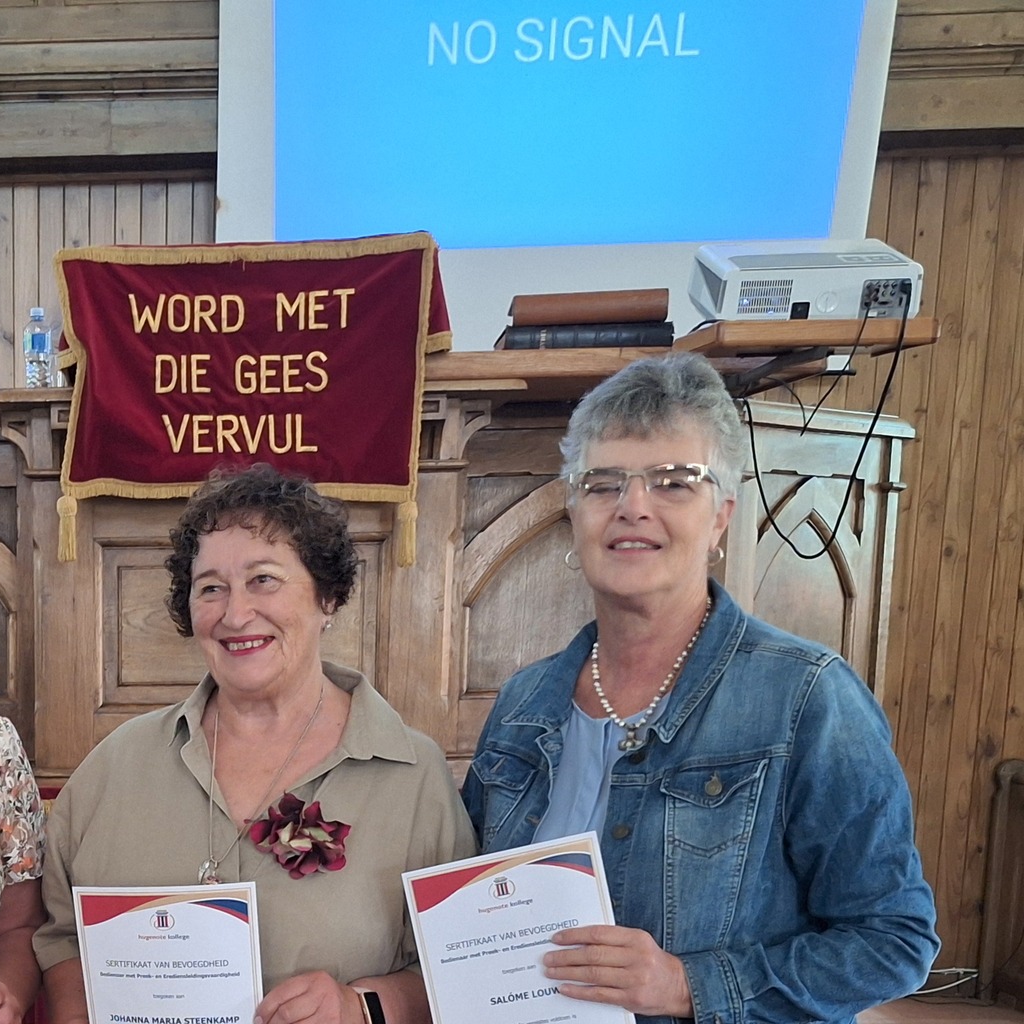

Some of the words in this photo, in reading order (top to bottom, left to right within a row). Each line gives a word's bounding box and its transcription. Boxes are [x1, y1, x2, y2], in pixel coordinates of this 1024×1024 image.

[428, 20, 497, 65] NO
[514, 12, 699, 62] SIGNAL
[128, 293, 245, 333] WORD
[276, 288, 355, 332] MET
[155, 354, 211, 394] DIE
[235, 351, 329, 394] GEES
[161, 413, 318, 454] VERVUL
[445, 935, 497, 952] SERTIFIKAAT
[499, 931, 517, 940] VAN
[519, 919, 579, 937] BEVOEGDHEID
[105, 960, 151, 969] SERTIFIKAAT
[173, 960, 229, 968] BEVOEGDHEID
[490, 991, 529, 1005] SALÓME
[532, 986, 560, 998] LOUW
[110, 1014, 150, 1024] JOHANNA
[152, 1017, 182, 1024] MARIA
[184, 1016, 240, 1024] STEENKAMP
